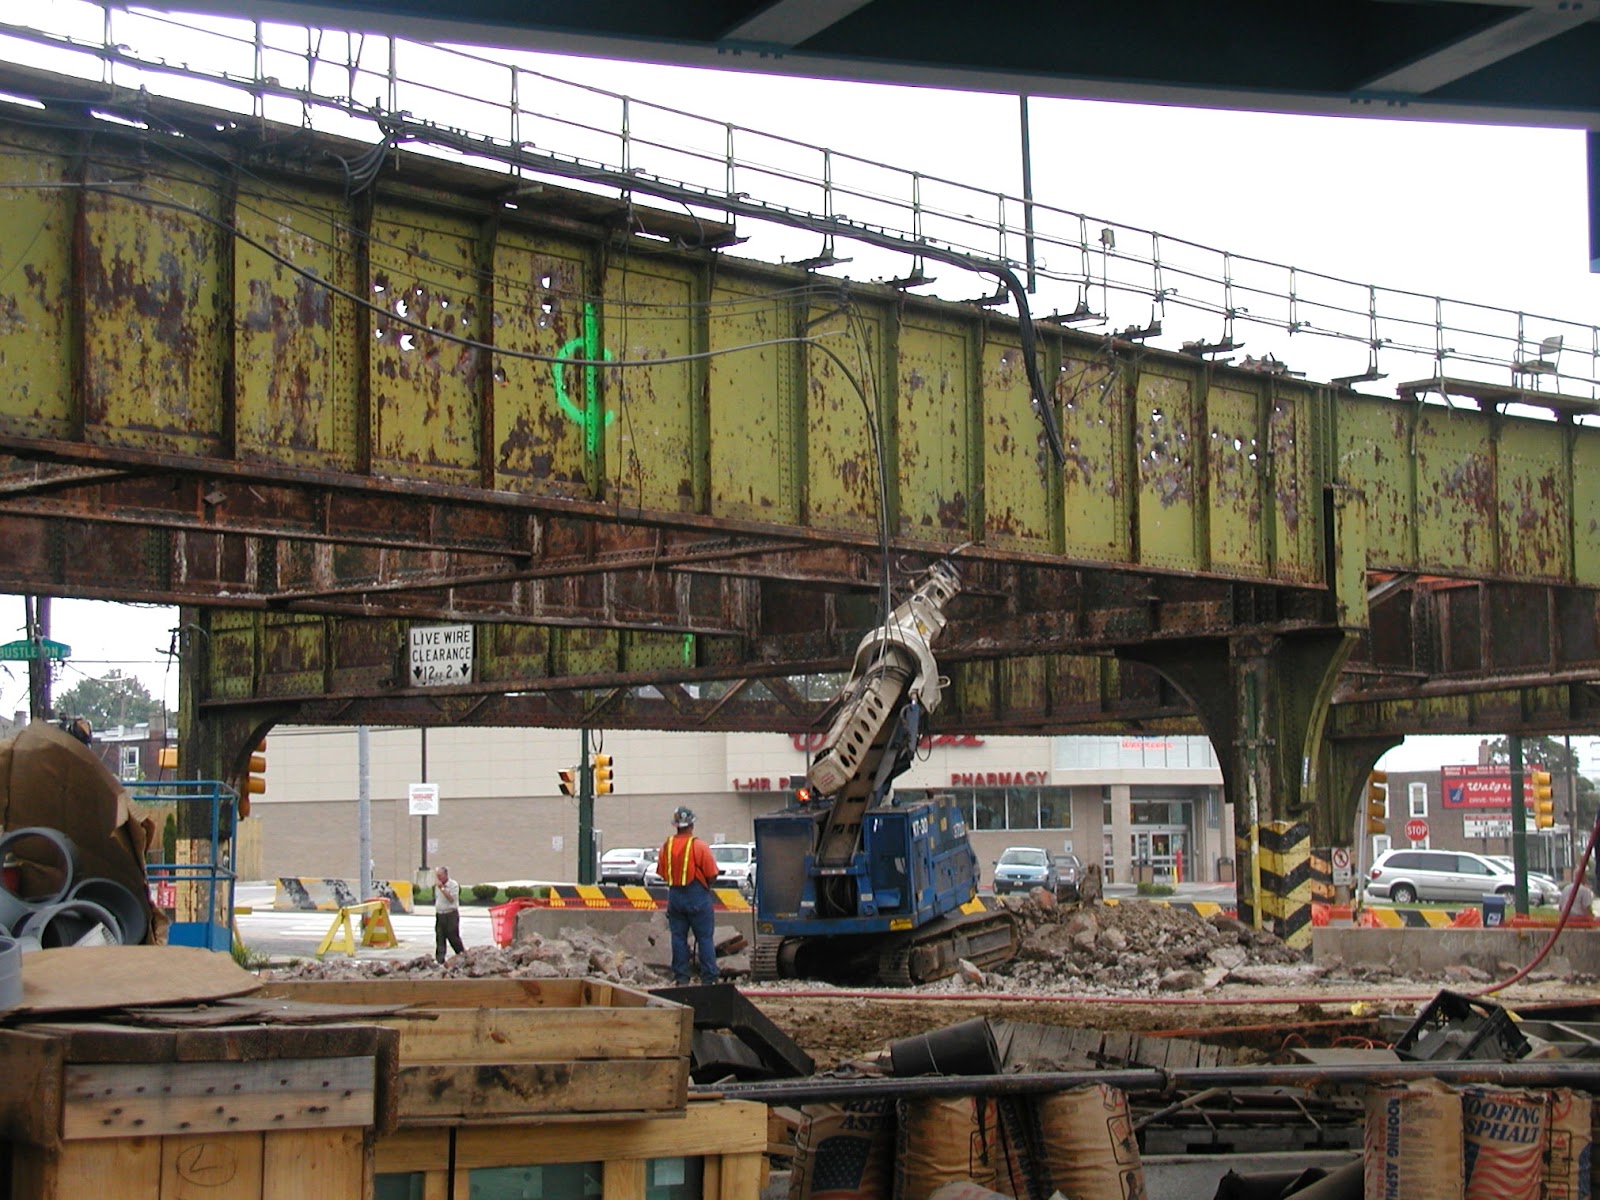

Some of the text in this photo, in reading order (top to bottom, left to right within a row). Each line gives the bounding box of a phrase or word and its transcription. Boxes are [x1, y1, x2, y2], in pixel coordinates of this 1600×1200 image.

[413, 630, 471, 646] LIVE WIRE
[0, 645, 59, 659] BUSTLEON
[412, 646, 471, 663] CLEARANCE
[424, 665, 435, 680] 12
[446, 664, 453, 679] 2
[951, 771, 1048, 787] PHARMACY
[1406, 824, 1427, 836] STOP
[1464, 1118, 1540, 1144] SPHALT
[1385, 1098, 1400, 1200] ROOFING ASPH
